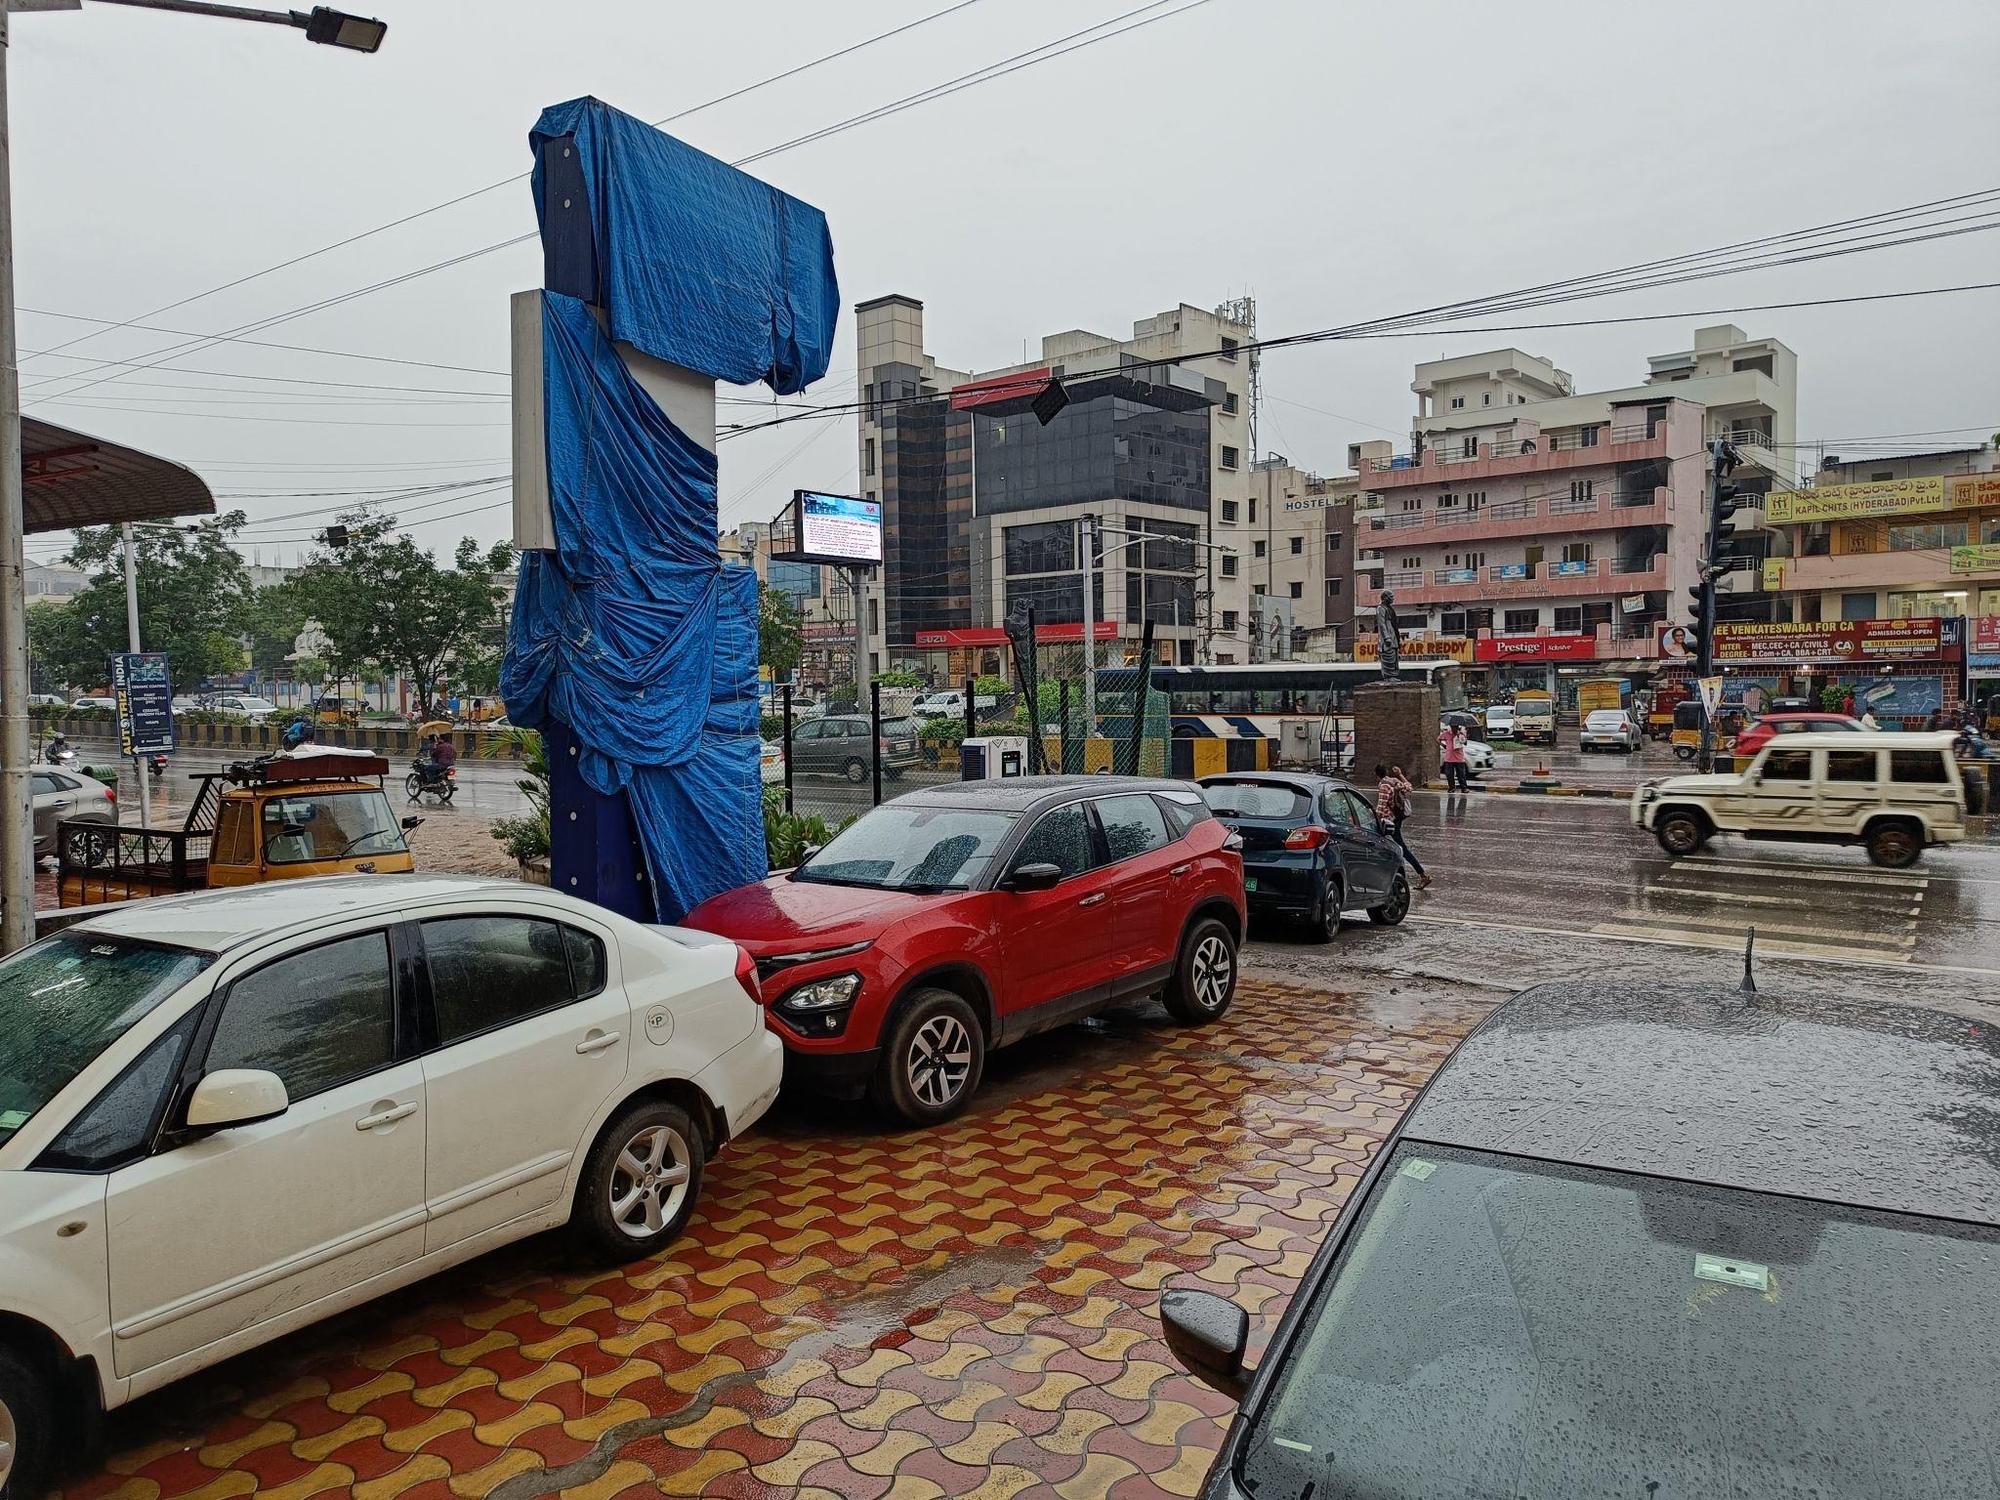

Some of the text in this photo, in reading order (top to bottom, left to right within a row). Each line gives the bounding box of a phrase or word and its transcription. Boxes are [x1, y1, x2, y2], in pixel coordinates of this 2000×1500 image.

[1285, 498, 1332, 511] HOSTEL
[1795, 505, 1820, 515] KAPIL
[1822, 501, 1848, 513] CHITS
[1731, 623, 1812, 635] VENKATESWARA
[1816, 622, 1837, 633] FOR
[1839, 621, 1855, 632] CA
[1868, 629, 1911, 637] ADMISSIONS
[1913, 628, 1933, 636] OPEN
[1427, 641, 1467, 654] REDDY
[1496, 642, 1541, 653] Prestige
[1721, 643, 1741, 651] INTER
[1835, 641, 1852, 650] CA
[114, 656, 126, 686] INDIA
